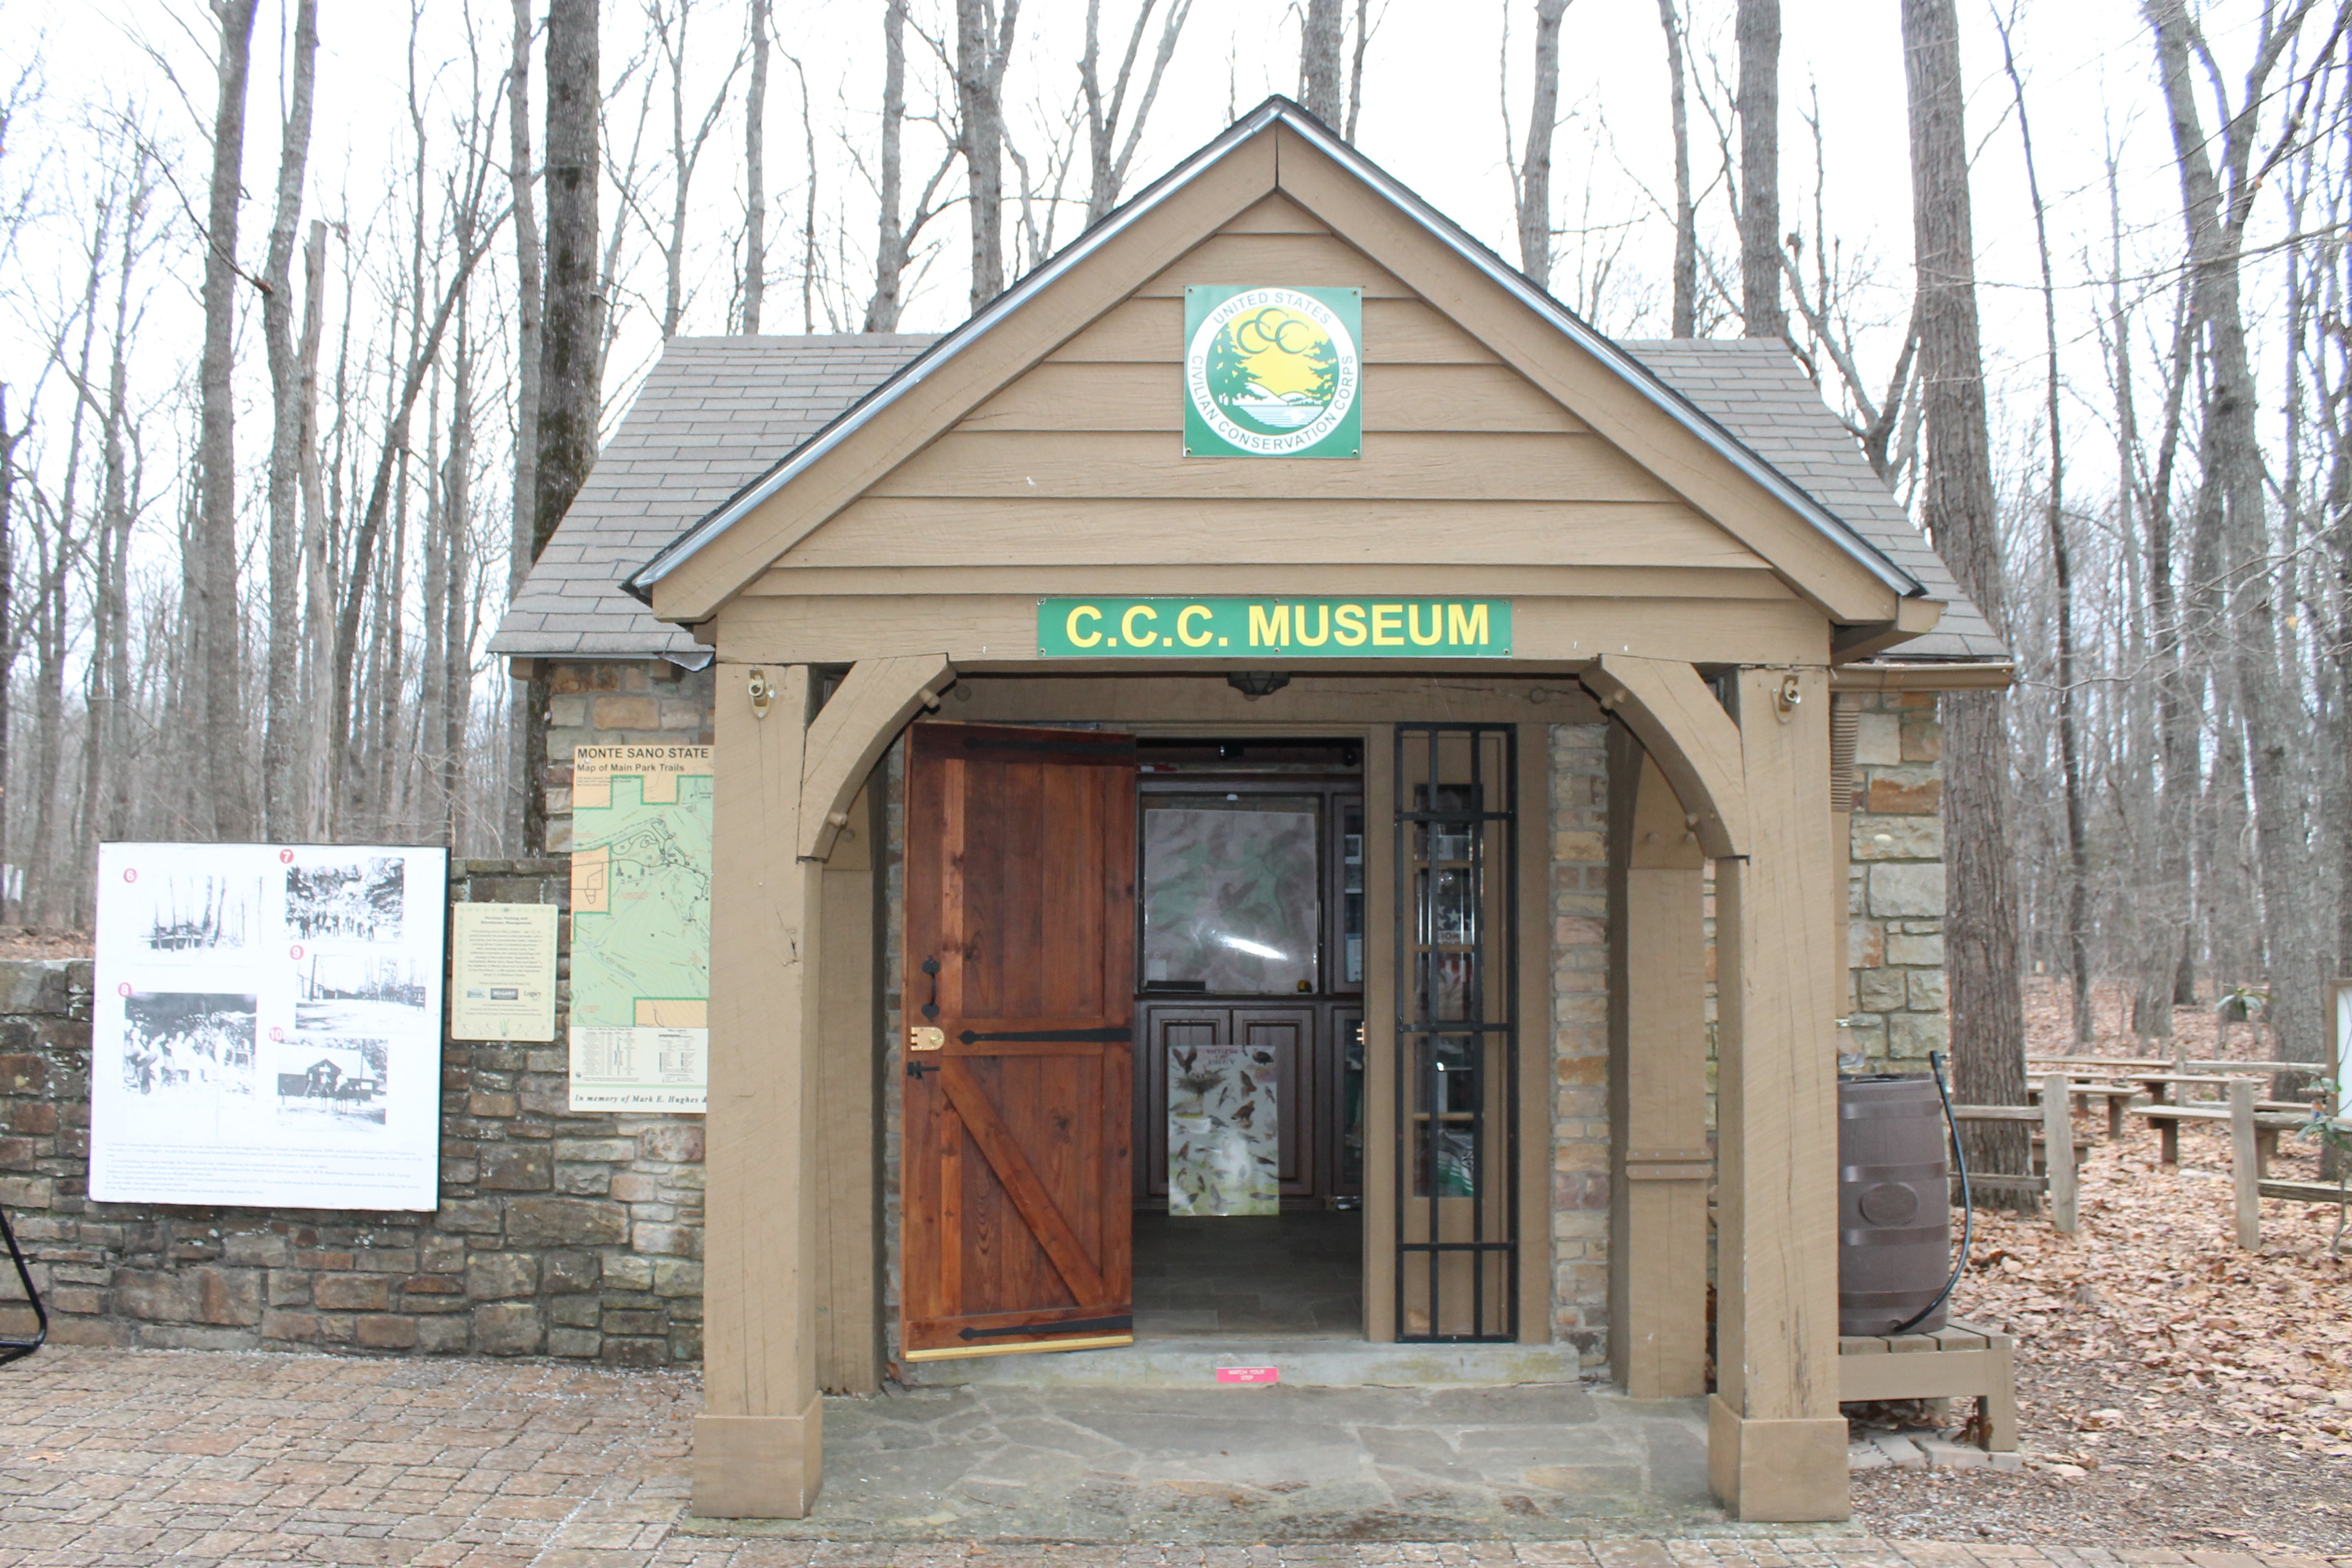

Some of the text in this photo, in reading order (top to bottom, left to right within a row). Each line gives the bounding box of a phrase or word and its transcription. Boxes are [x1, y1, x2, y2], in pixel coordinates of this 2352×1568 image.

[1213, 292, 1331, 325] UNITED STATES
[1191, 355, 1353, 450] CIVILIAN CONSERVATION CORPS
[1066, 604, 1489, 647] C.C.C. MUSEUM
[578, 748, 709, 758] MONTE SANO STATE
[576, 764, 596, 773] Map
[282, 851, 292, 862] 7
[126, 871, 135, 881] 6
[292, 946, 301, 958] 9
[121, 984, 129, 996] 8
[270, 1028, 283, 1041] 10
[620, 1095, 631, 1103] of
[668, 1096, 699, 1104] Hughes
